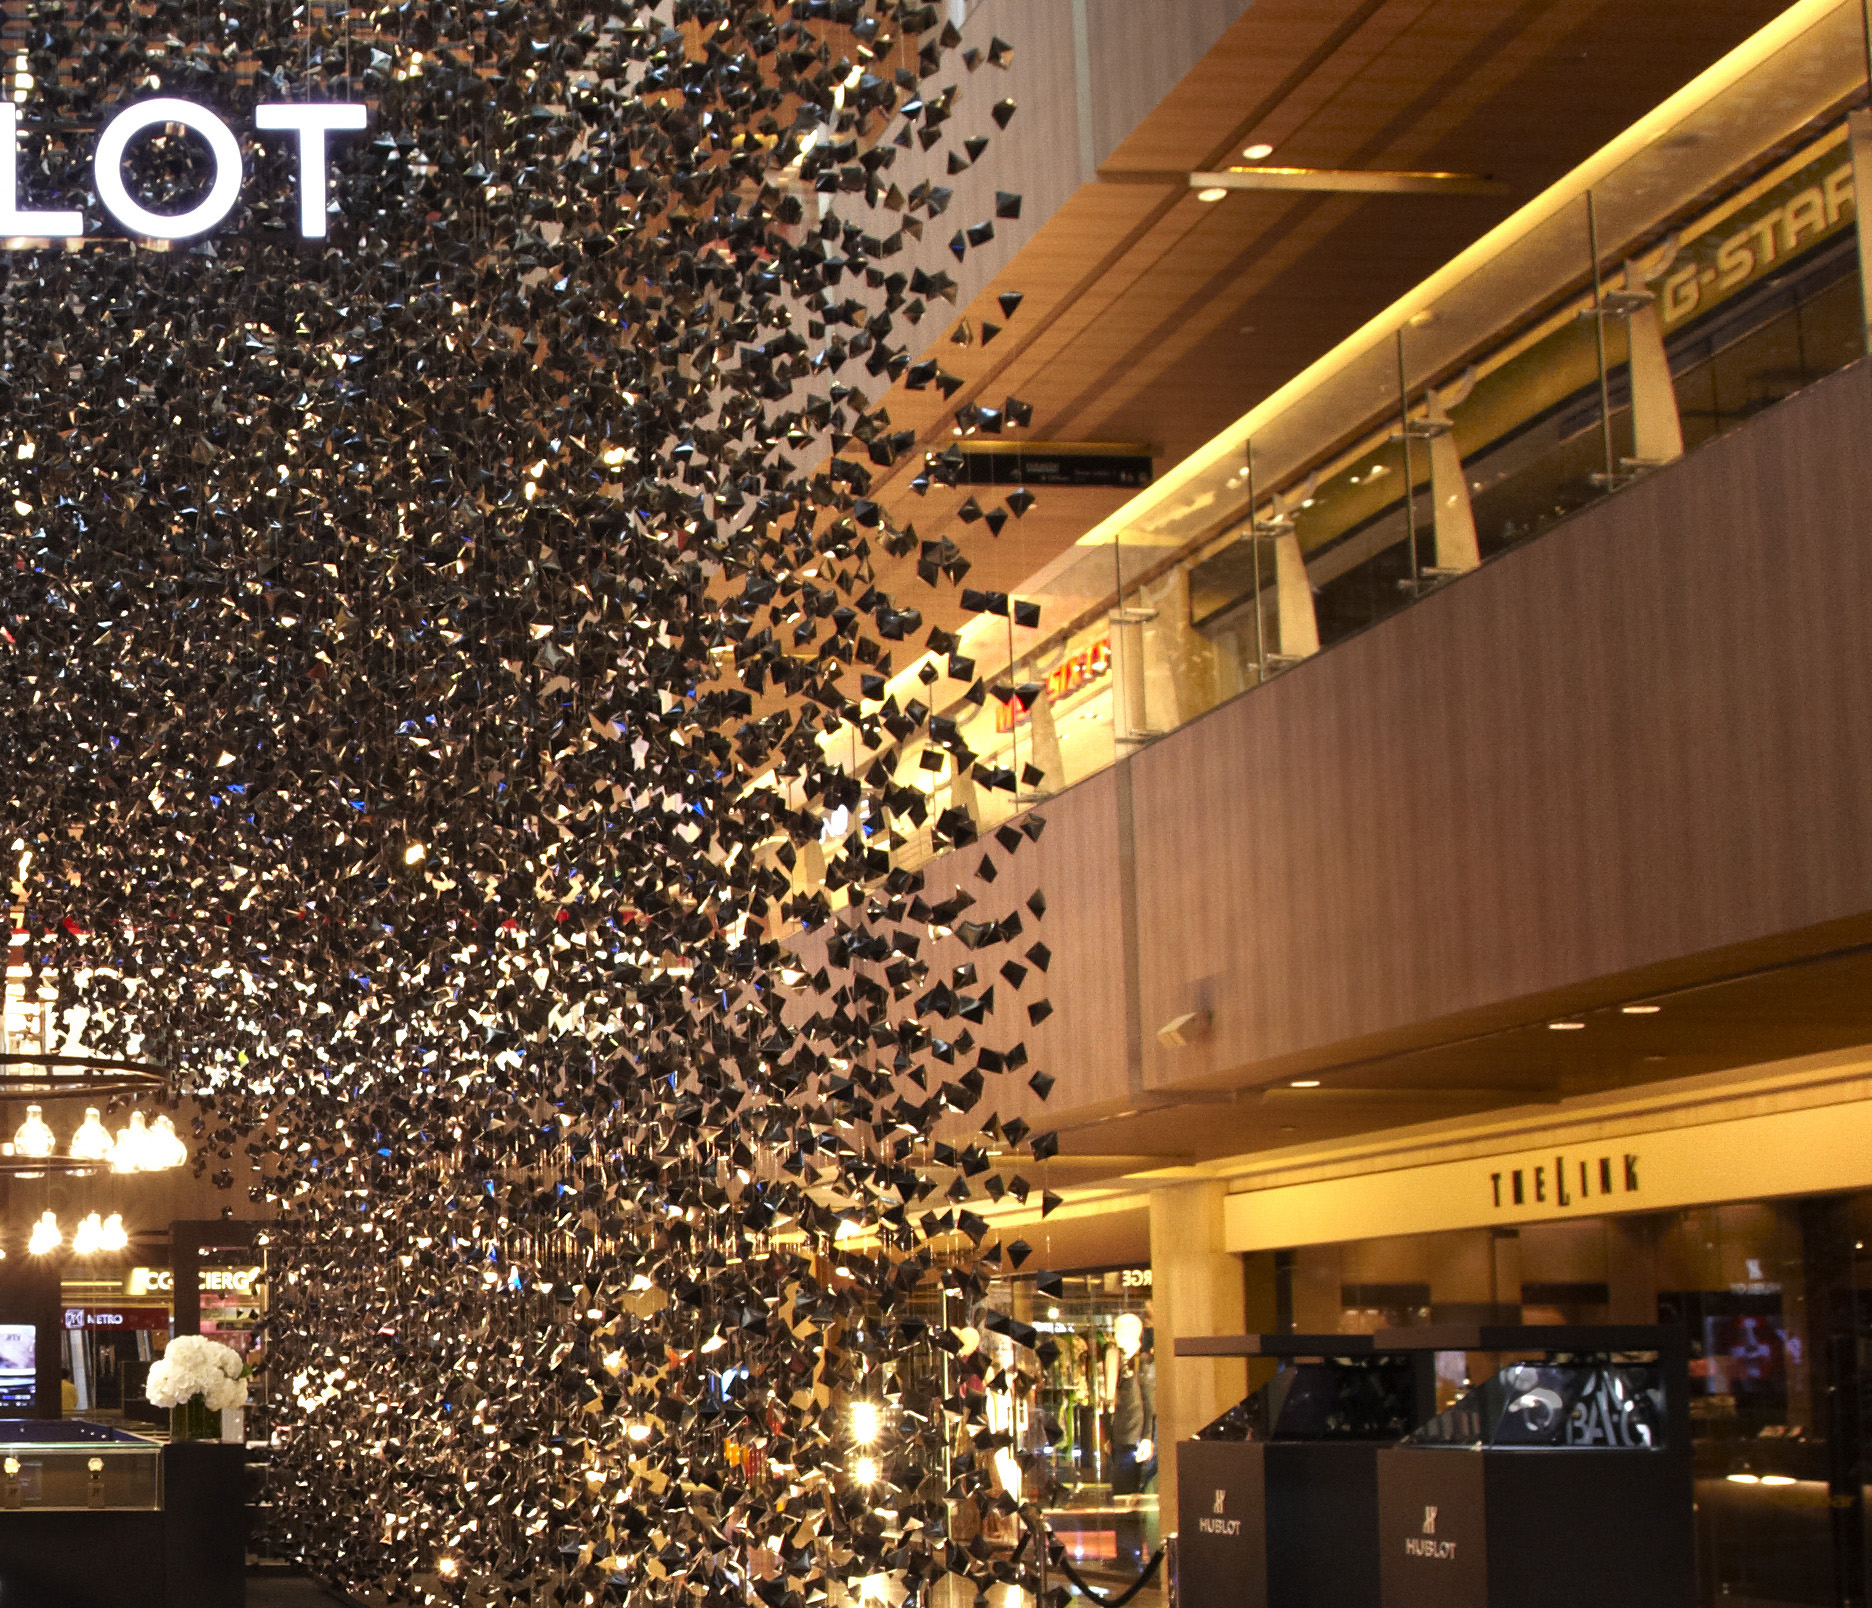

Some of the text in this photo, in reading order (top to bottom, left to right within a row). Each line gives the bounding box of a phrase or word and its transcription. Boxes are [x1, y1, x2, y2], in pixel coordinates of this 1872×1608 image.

[145, 1271, 257, 1290] COIERG
[1199, 1517, 1241, 1536] HUBLOT
[1405, 1538, 1457, 1560] HUBLOT
